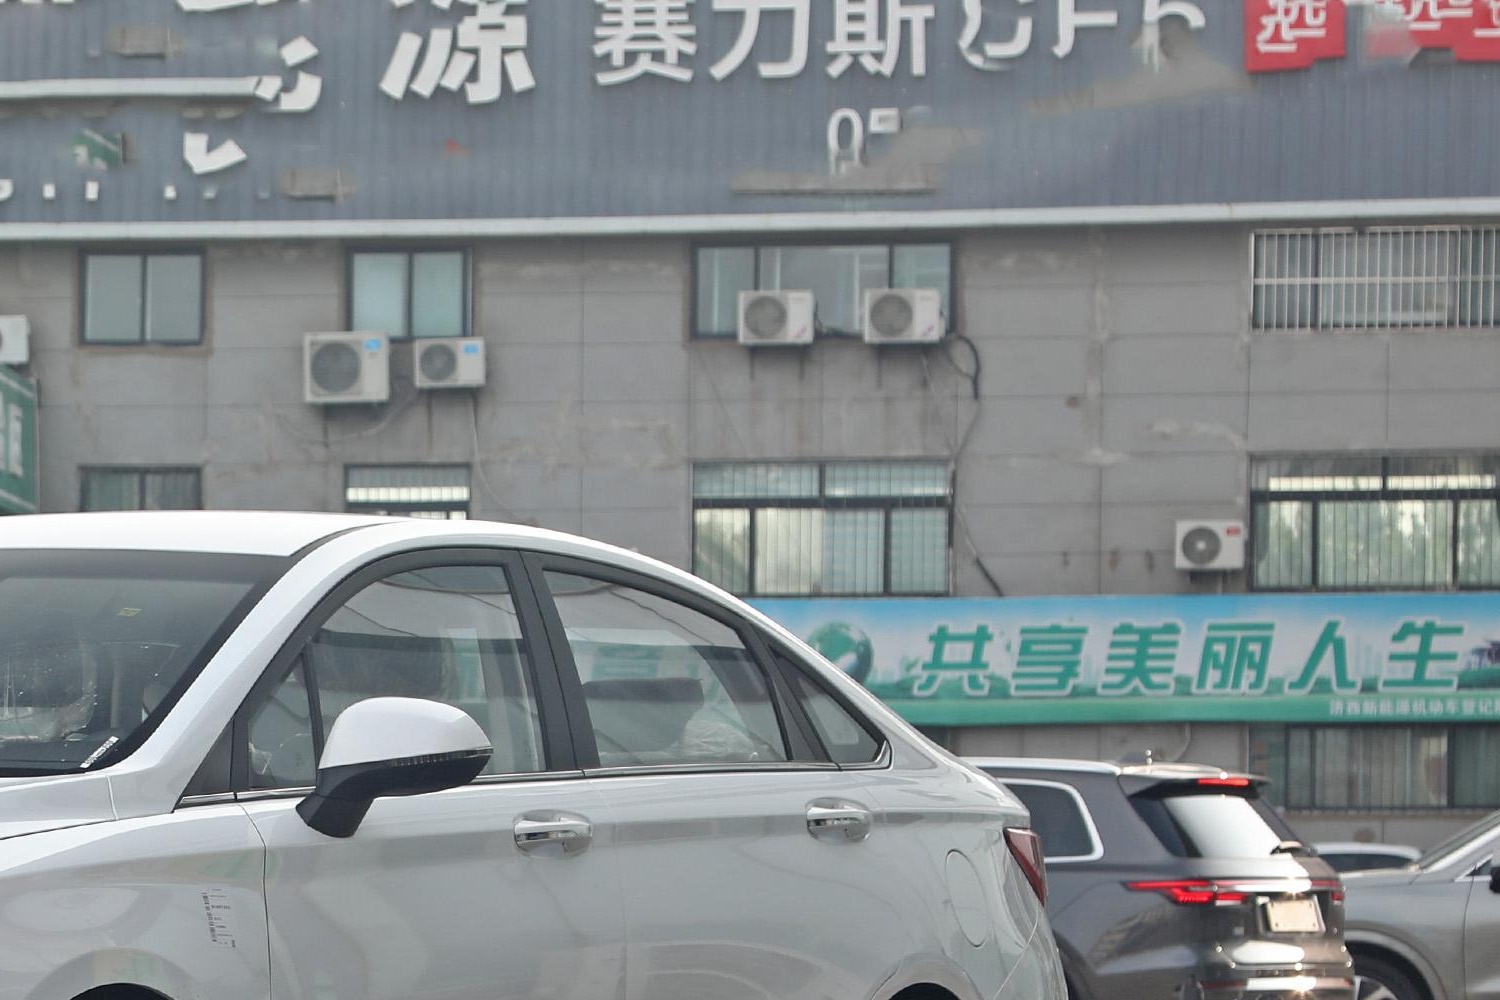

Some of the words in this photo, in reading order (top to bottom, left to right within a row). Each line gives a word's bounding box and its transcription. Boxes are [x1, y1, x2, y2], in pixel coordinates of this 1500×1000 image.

[593, 0, 936, 86] 赛力斯
[914, 618, 1467, 695] 共享美丽人生
